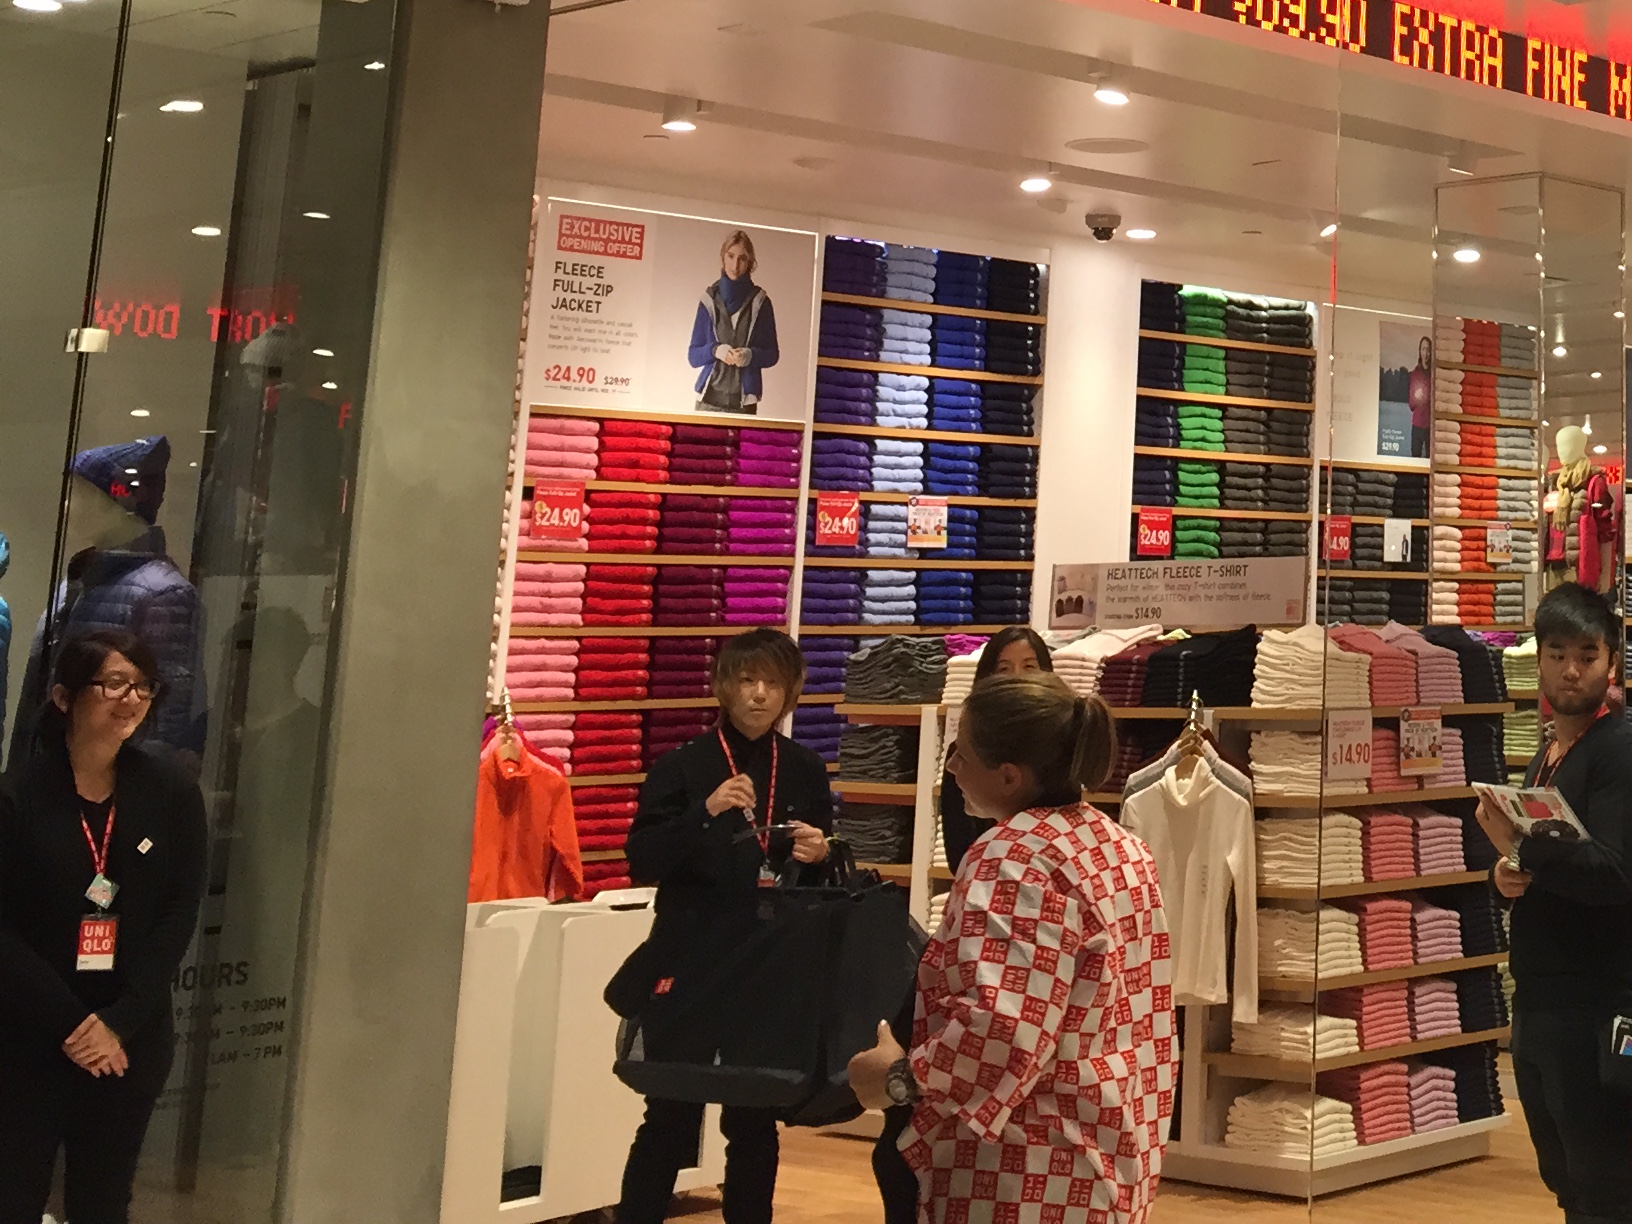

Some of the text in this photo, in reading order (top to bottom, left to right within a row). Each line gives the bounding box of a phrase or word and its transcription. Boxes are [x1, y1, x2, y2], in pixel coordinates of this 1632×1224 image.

[1394, 2, 1502, 88] EXTRA
[1526, 38, 1588, 110] FINE
[561, 218, 642, 244] EXCLUSIVE
[560, 237, 640, 257] OPENING OFFER
[554, 261, 605, 279] FLEECE
[552, 279, 614, 297] FULL-ZIP
[551, 296, 602, 314] JACKET
[544, 364, 596, 384] $24.90
[535, 506, 580, 527] $24.90
[1140, 530, 1170, 545] $24.90
[1107, 564, 1249, 580] HEATTECH FLEECE T-SHIRT
[1135, 607, 1162, 620] $14.90
[1332, 742, 1370, 766] $14.90
[84, 926, 110, 937] UNI
[83, 939, 111, 953] QLO
